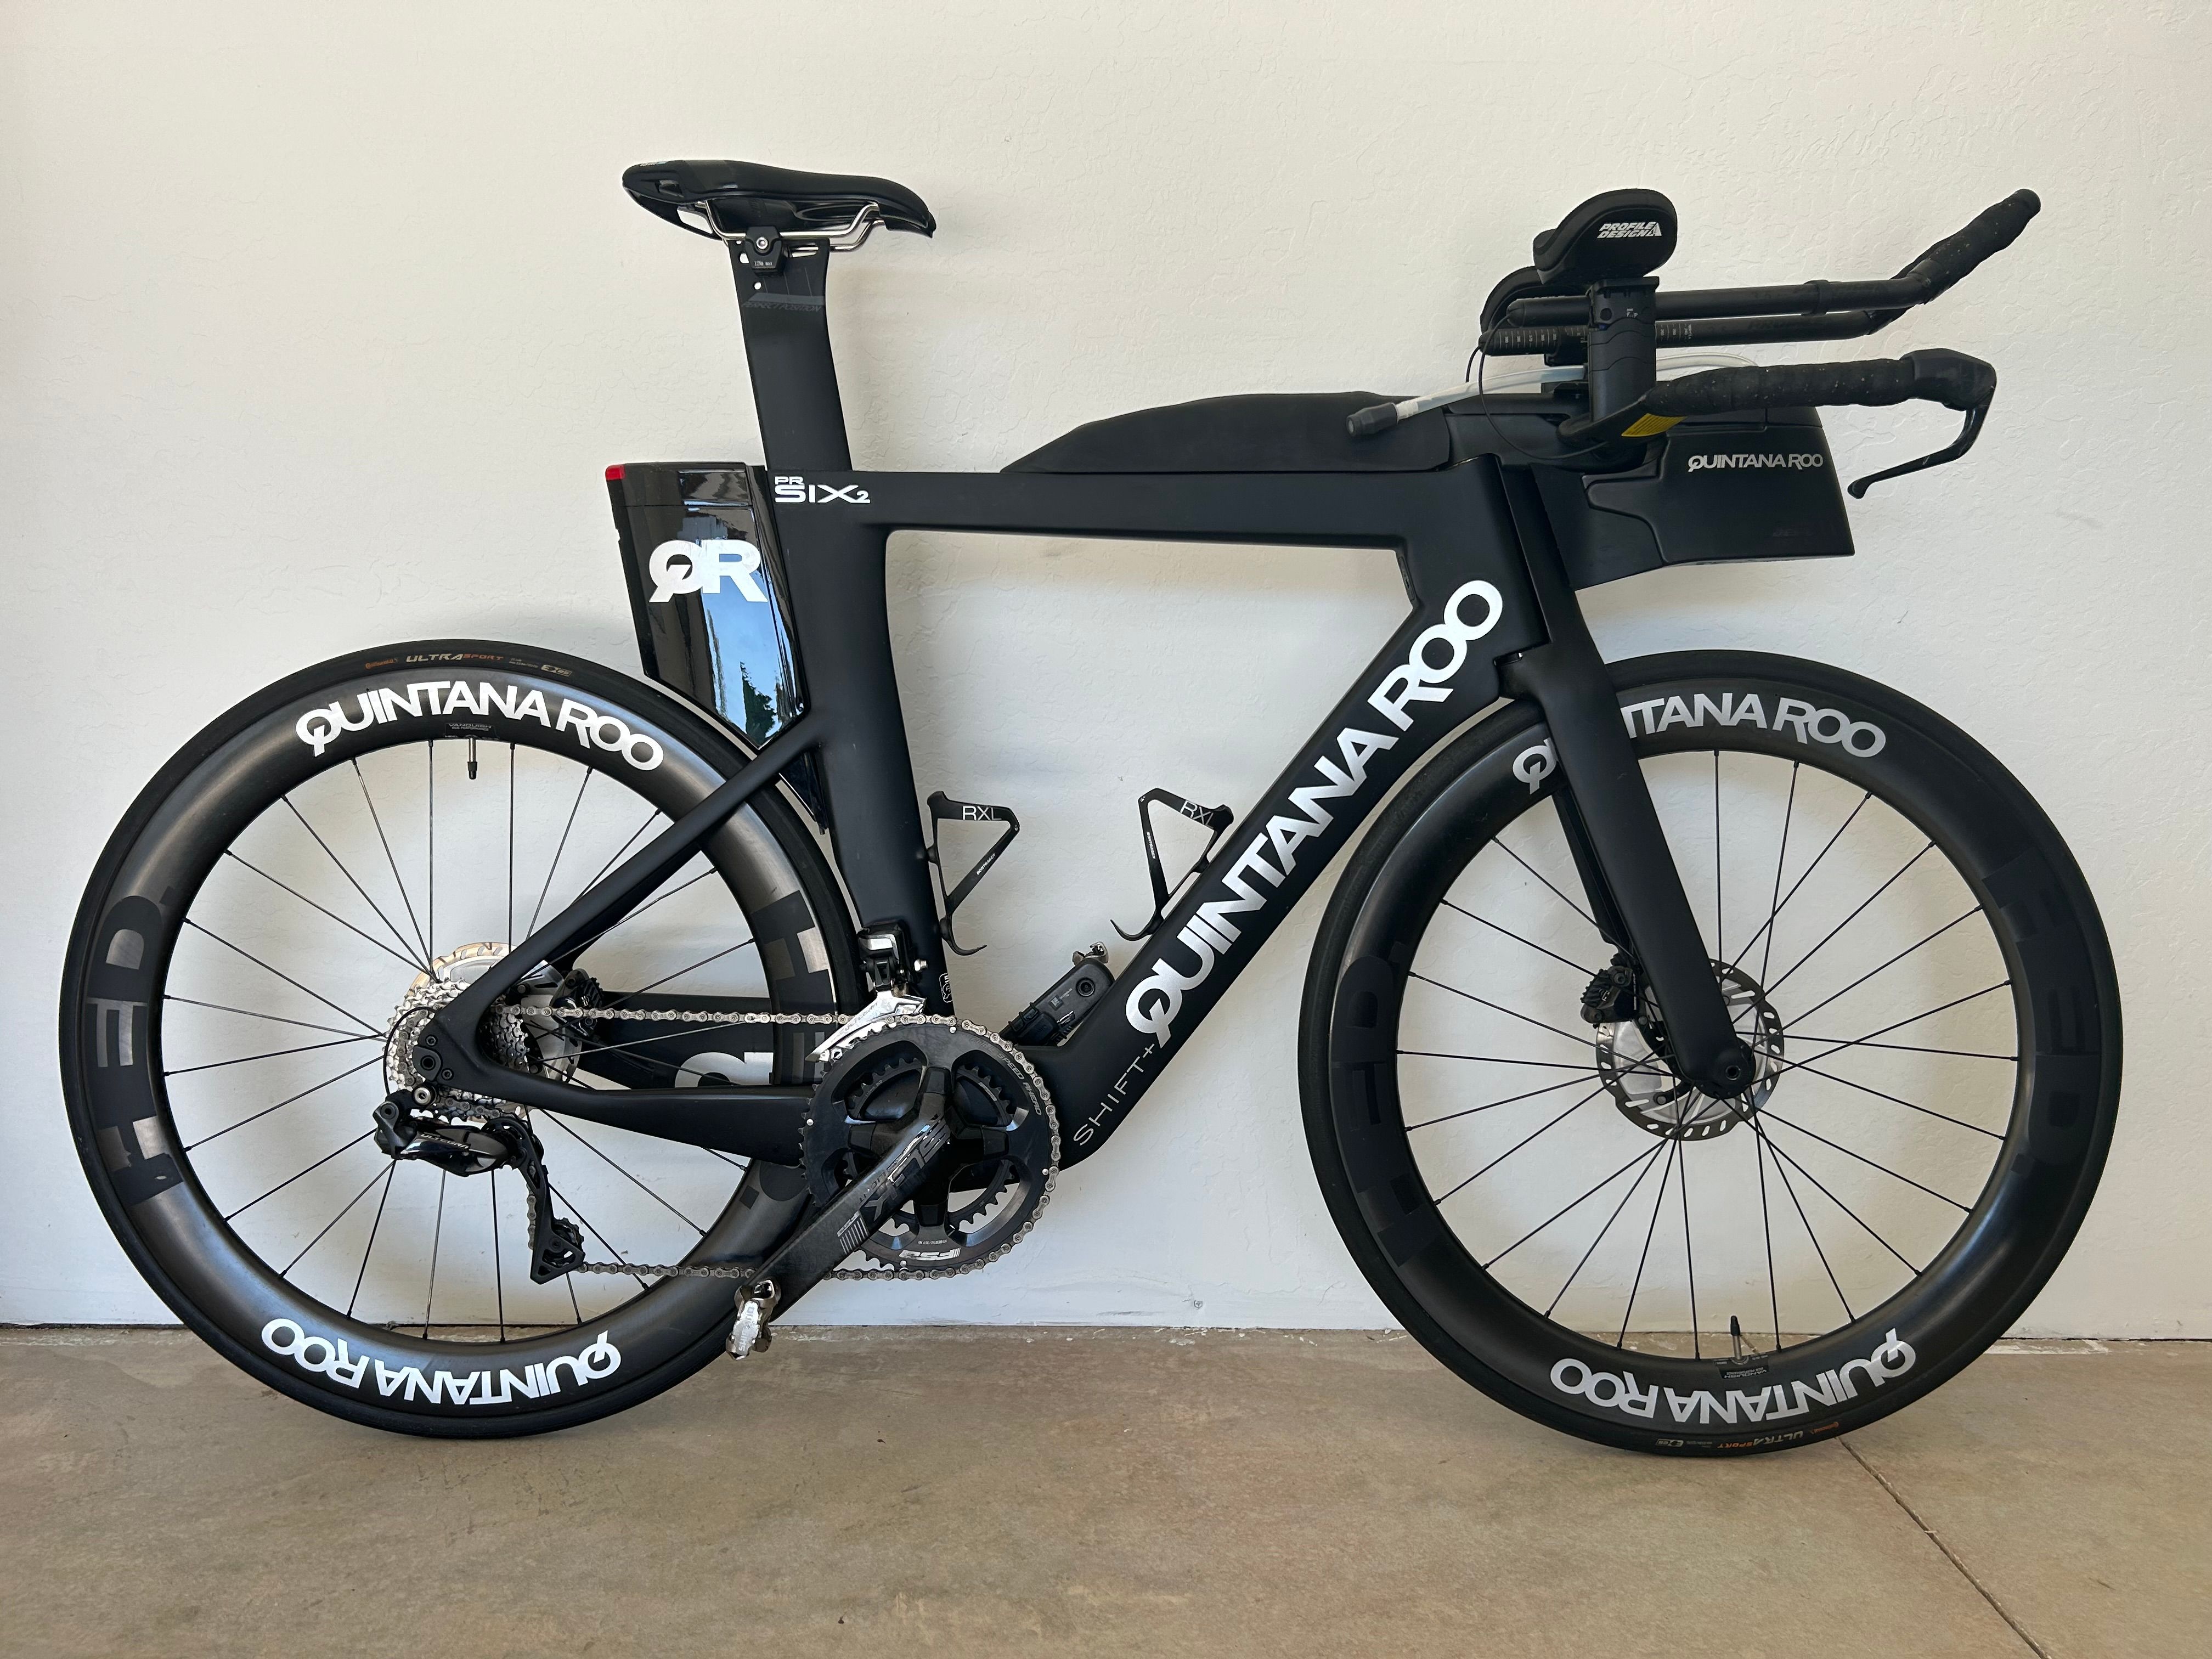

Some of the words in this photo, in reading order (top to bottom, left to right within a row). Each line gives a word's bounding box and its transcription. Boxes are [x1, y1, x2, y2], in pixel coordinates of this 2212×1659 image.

[1596, 229, 1651, 239] DESIGN
[1599, 221, 1657, 232] PROFILE
[774, 476, 804, 485] PR
[1688, 454, 1786, 472] QUINTANA
[1788, 454, 1823, 470] ROO
[648, 539, 769, 603] QR
[296, 681, 551, 757] QUINTANA
[555, 698, 664, 771] ROO
[1512, 692, 1768, 795] QTANA
[1772, 697, 1886, 758] ROO
[962, 805, 1002, 822] RXL
[1125, 726, 1400, 1049] QUINTANA
[1367, 579, 1504, 732] ROO
[1180, 799, 1215, 829] RXL
[975, 852, 996, 876] BONTRAGER
[1146, 831, 1156, 860] BONTRAGER
[997, 1053, 1025, 1080] SPEED
[1022, 1081, 1042, 1116] AHEAD
[1073, 1042, 1156, 1146] SHIFT+
[420, 1132, 470, 1150] ULTEGRA
[261, 1318, 370, 1389] ROO
[374, 1330, 622, 1406] QUINTANA
[1663, 1327, 1916, 1424] QUINTANA
[1550, 1358, 1659, 1419] ROO
